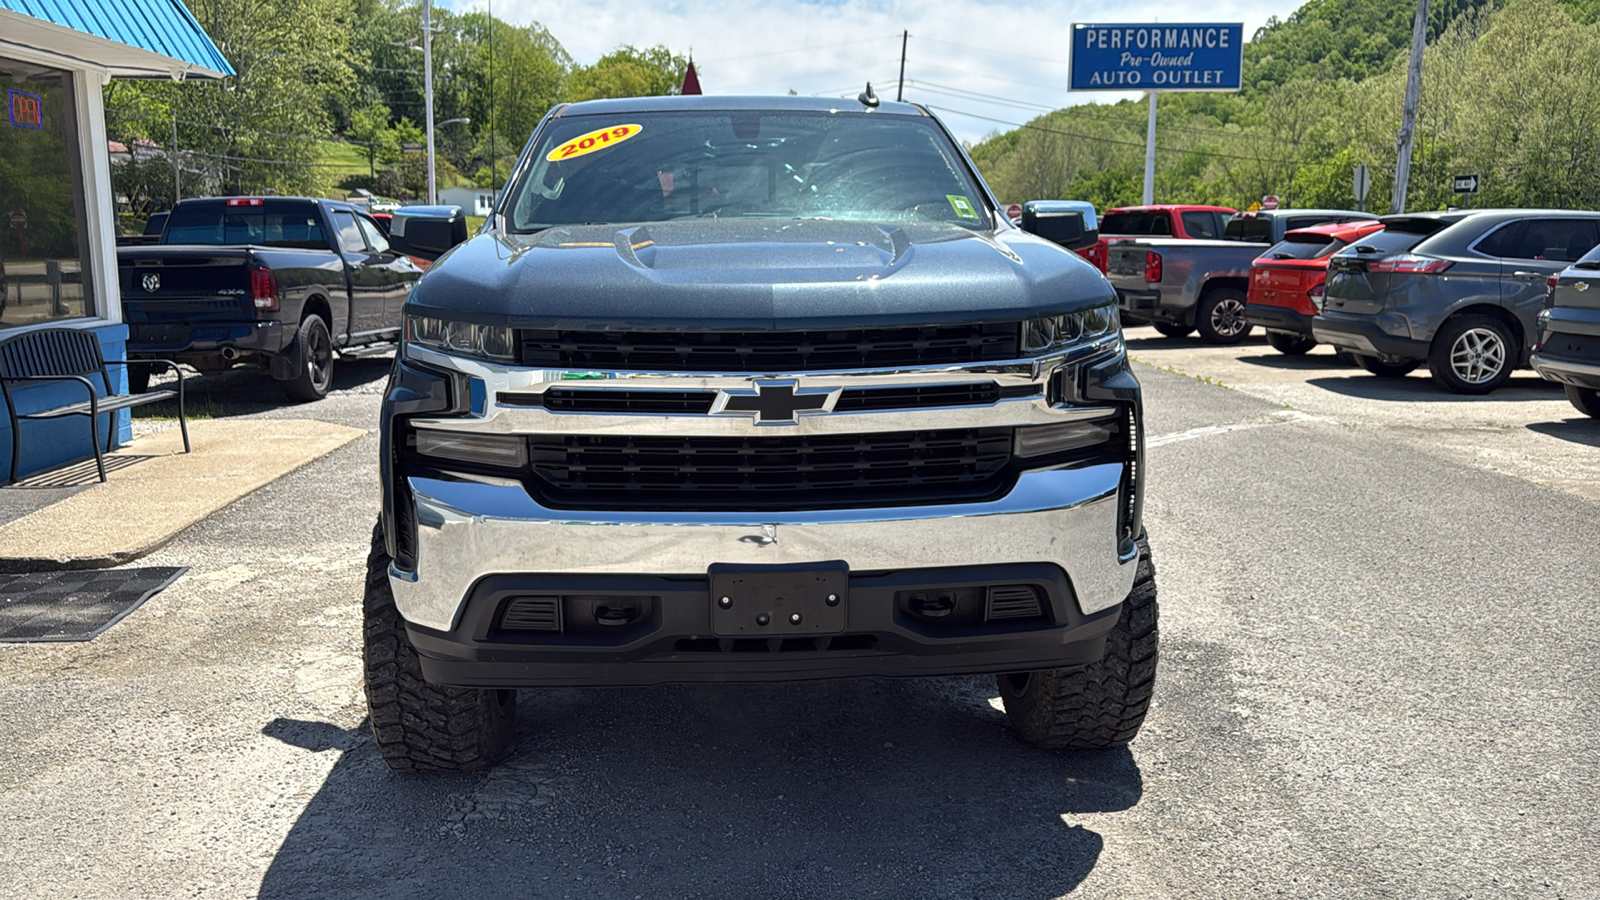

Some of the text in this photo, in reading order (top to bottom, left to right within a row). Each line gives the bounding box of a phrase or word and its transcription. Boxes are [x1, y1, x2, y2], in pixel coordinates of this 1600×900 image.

[1086, 28, 1230, 49] PERFORMANCE
[1119, 51, 1194, 67] Pre-Owned
[1089, 70, 1224, 85] AUTO OUTLET
[13, 94, 40, 124] OPEN
[560, 127, 630, 158] 2019
